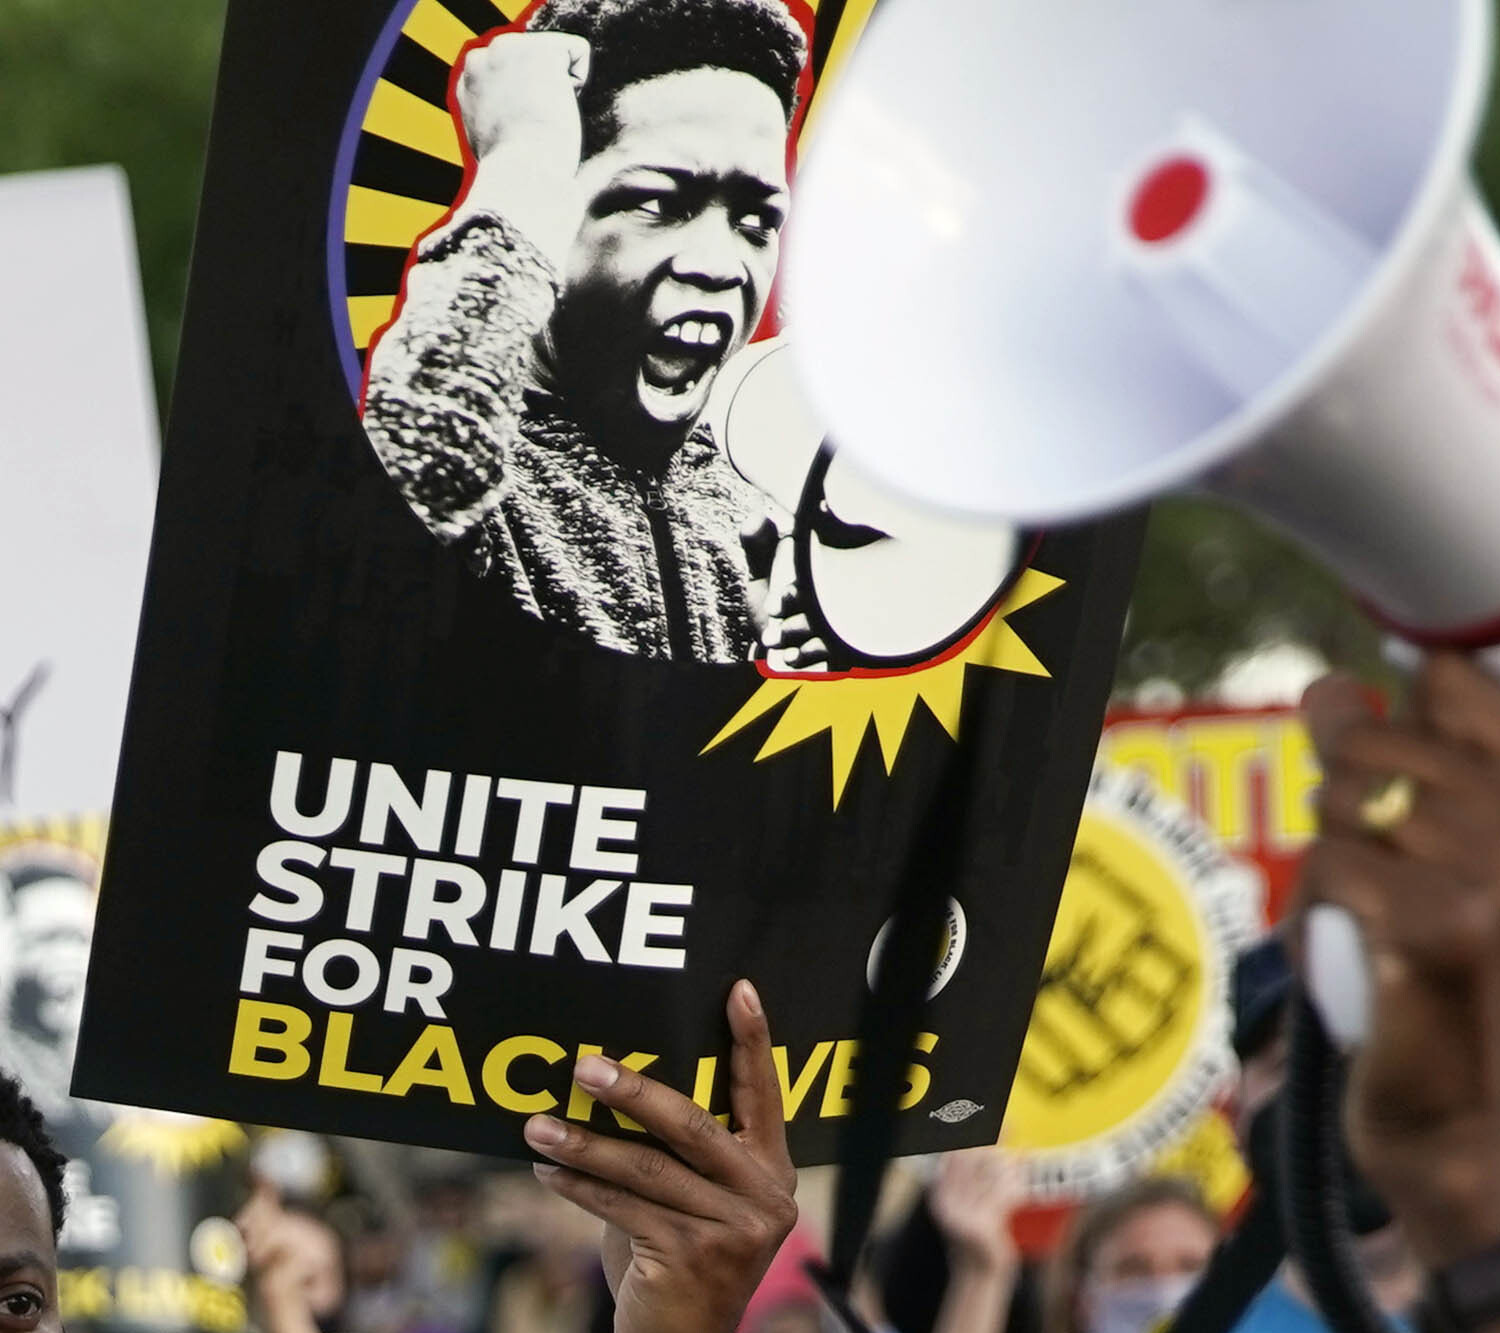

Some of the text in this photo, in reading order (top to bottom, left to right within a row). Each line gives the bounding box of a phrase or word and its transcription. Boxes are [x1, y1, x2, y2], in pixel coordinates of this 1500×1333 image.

[268, 750, 647, 875] UNITE
[247, 840, 694, 969] STRIKE
[238, 928, 454, 1019] FOR
[228, 999, 662, 1135] BLACK
